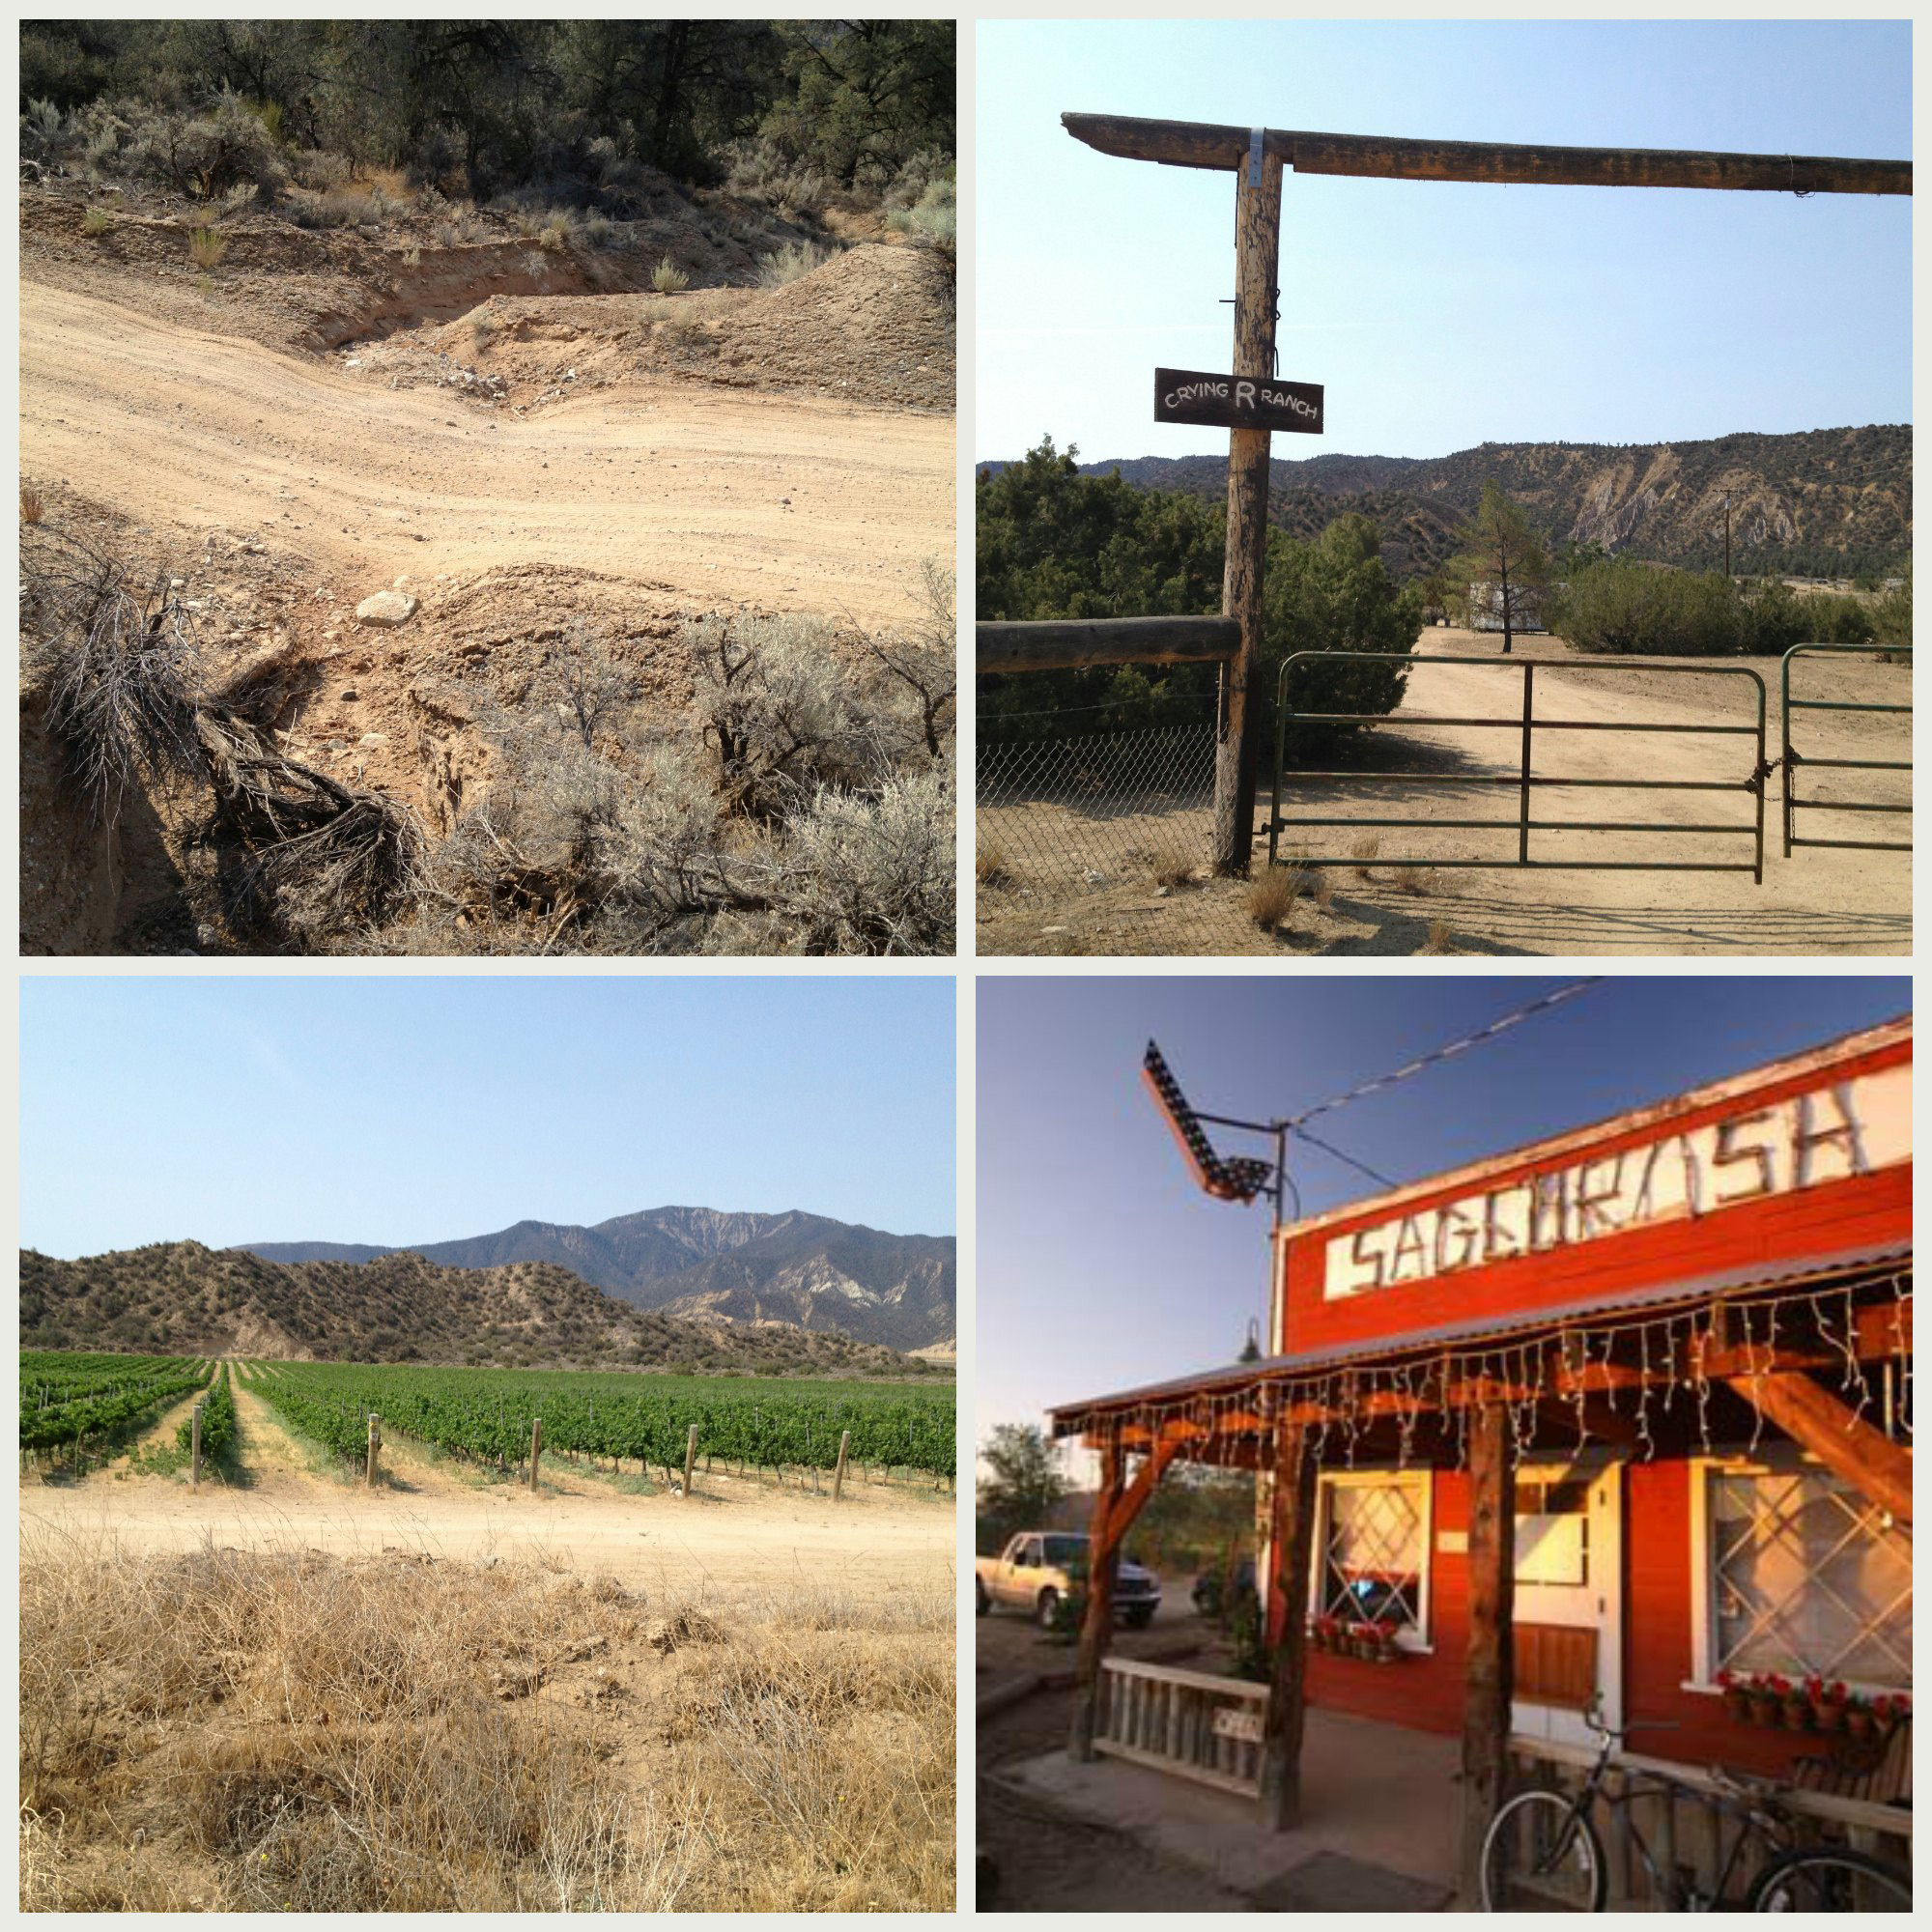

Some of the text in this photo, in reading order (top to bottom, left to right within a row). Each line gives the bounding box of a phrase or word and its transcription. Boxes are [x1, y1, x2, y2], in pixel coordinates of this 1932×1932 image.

[1165, 382, 1318, 419] CRYING R RANCH
